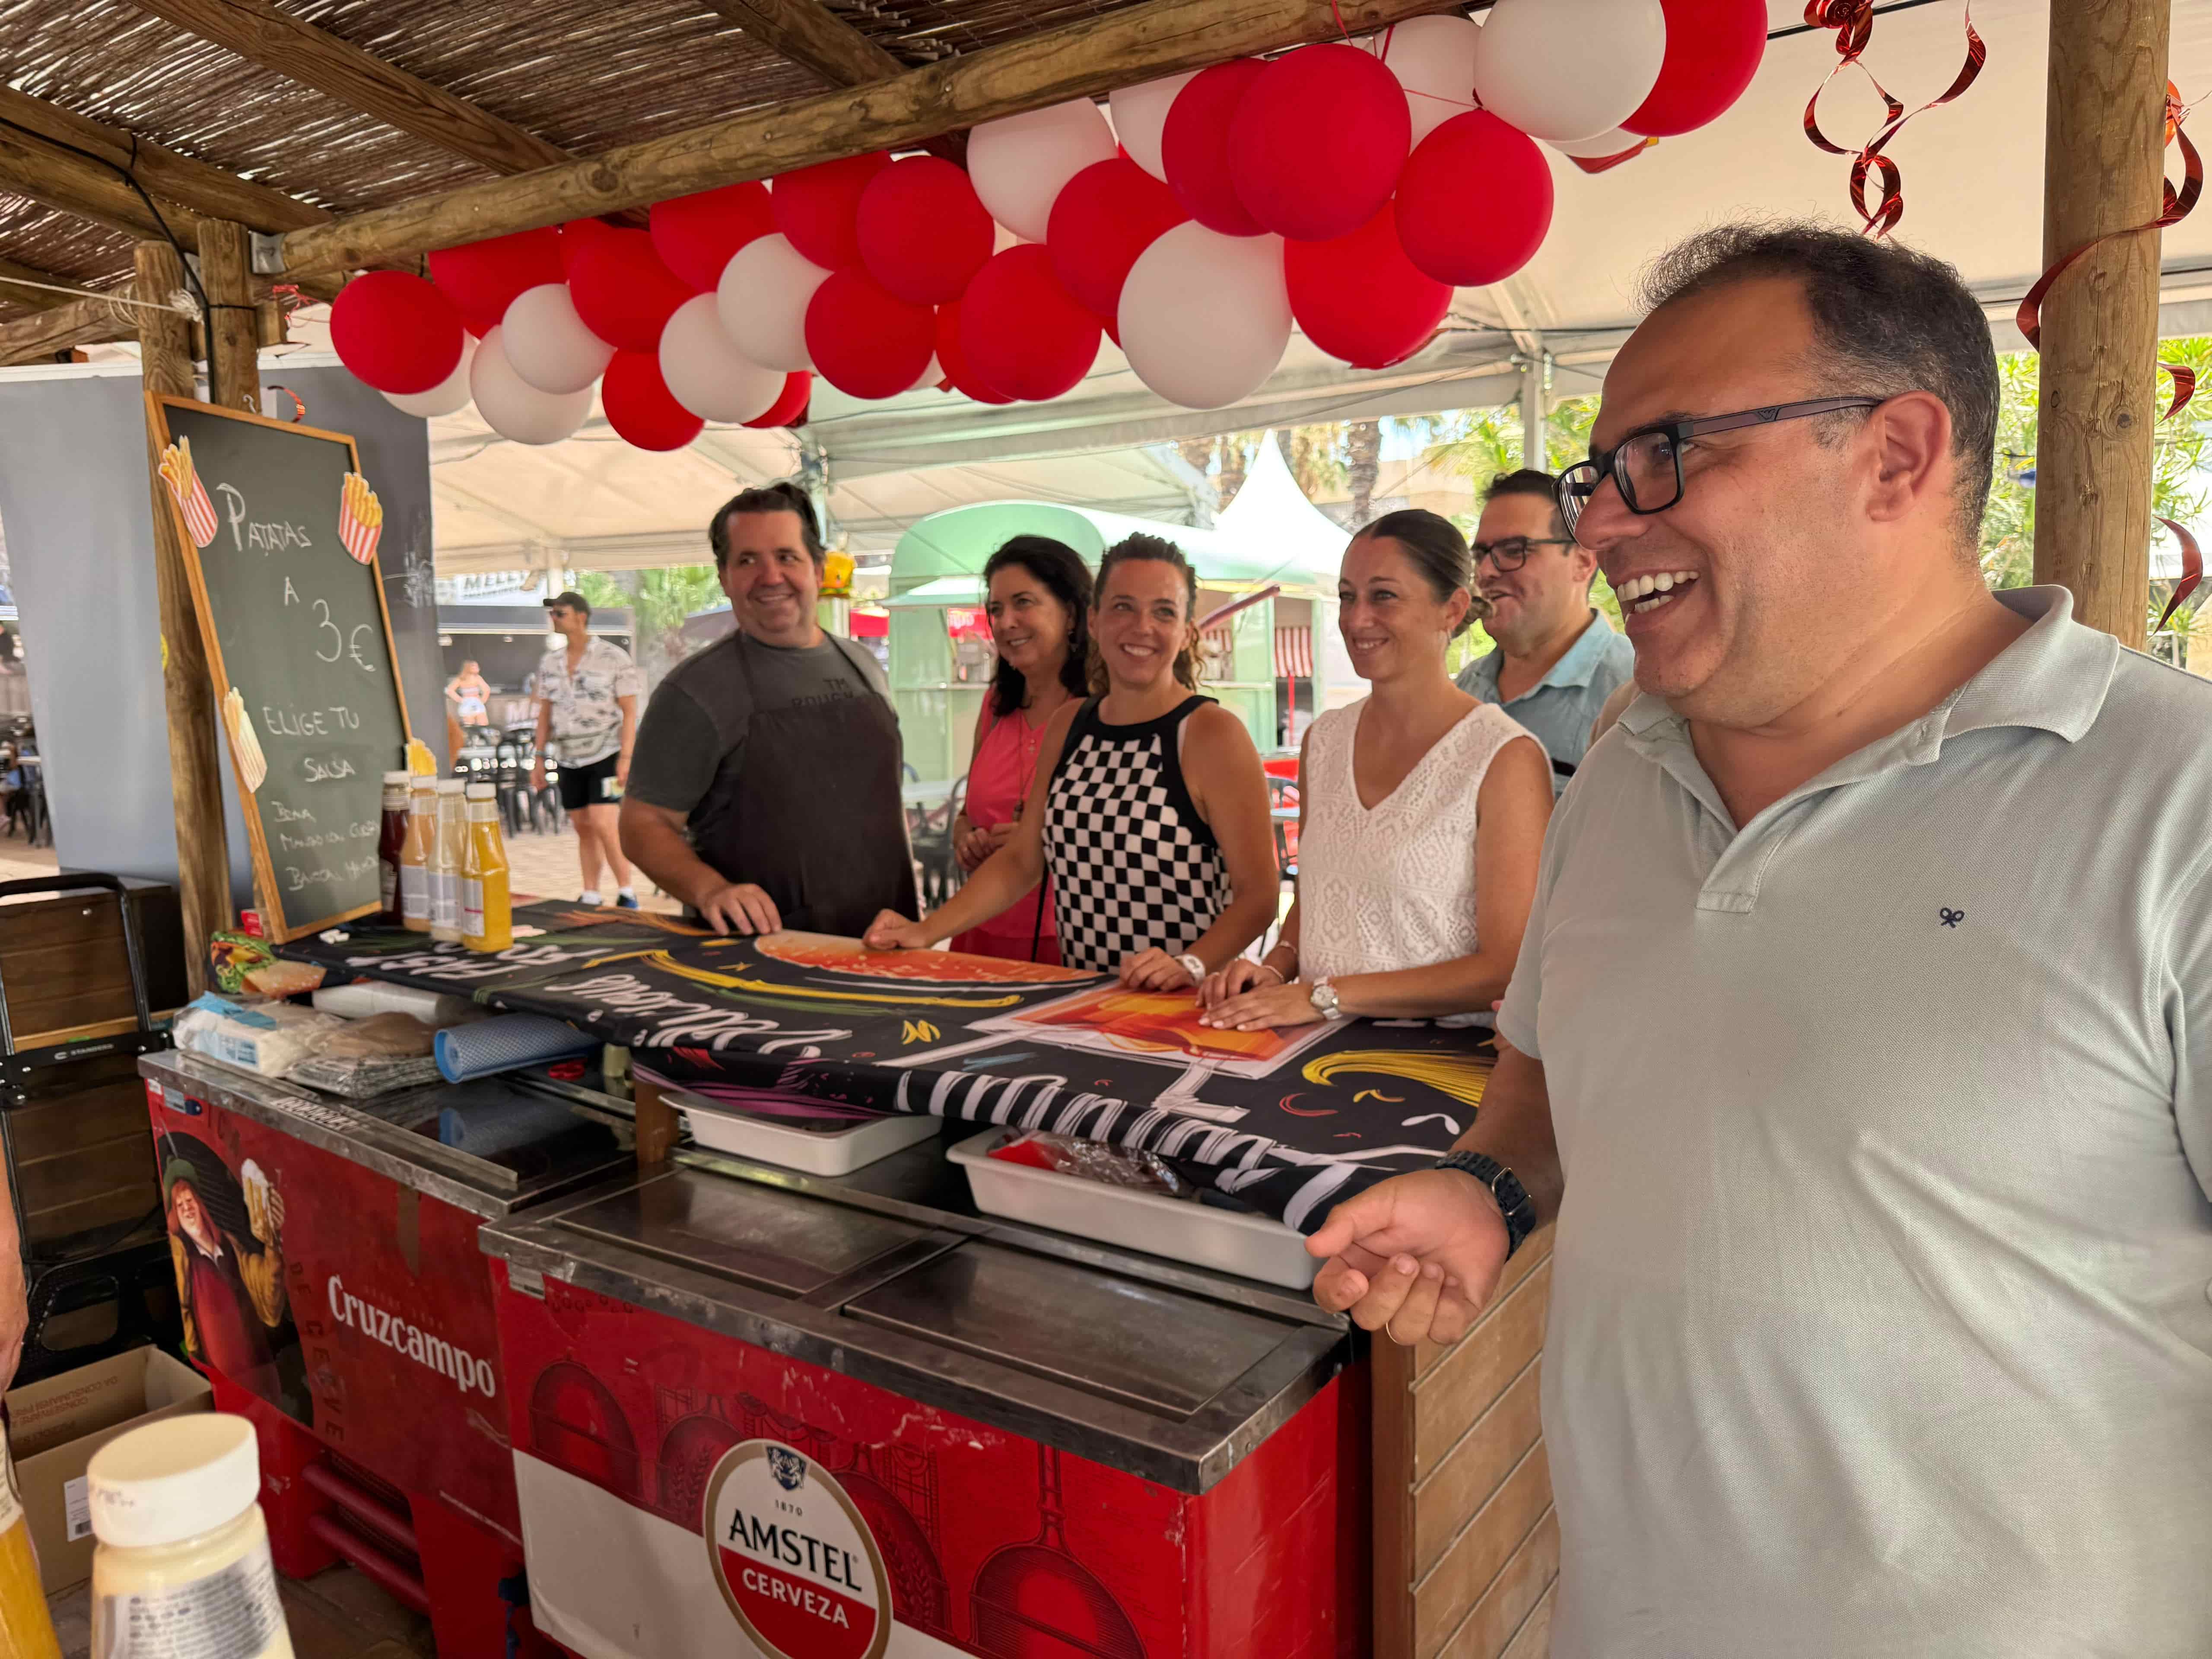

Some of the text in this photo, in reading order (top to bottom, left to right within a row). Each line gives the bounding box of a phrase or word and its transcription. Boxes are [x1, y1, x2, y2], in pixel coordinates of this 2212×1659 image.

[284, 577, 300, 605] A
[262, 706, 360, 736] ELIGE TU
[304, 757, 356, 783] SALSA
[327, 1274, 496, 1398] Cruzcampo
[775, 1499, 803, 1517] 1870
[729, 1509, 862, 1592] AMSTEL
[742, 1568, 850, 1629] CERVEZA
